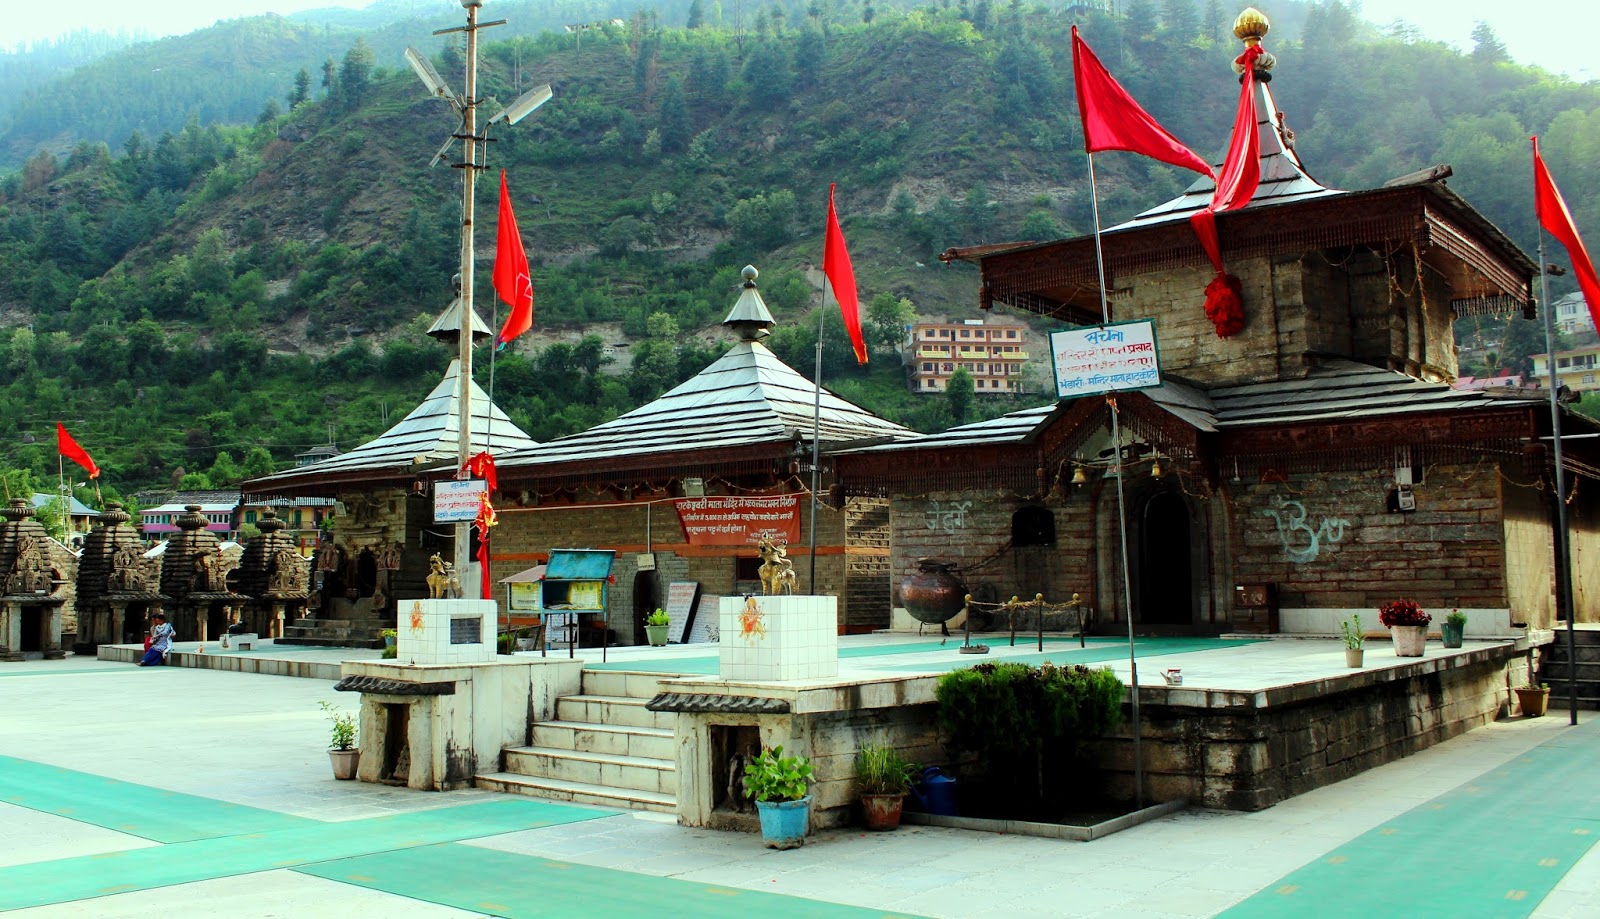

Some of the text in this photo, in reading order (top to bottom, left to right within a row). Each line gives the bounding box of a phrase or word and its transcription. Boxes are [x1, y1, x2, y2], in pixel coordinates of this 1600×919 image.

[1127, 342, 1153, 354] प्रसाद
[1088, 374, 1109, 385] मन्दिर
[1110, 373, 1125, 383] माता
[708, 500, 723, 509] माता
[723, 498, 738, 509] मंदिर
[780, 496, 797, 507] निर्माण
